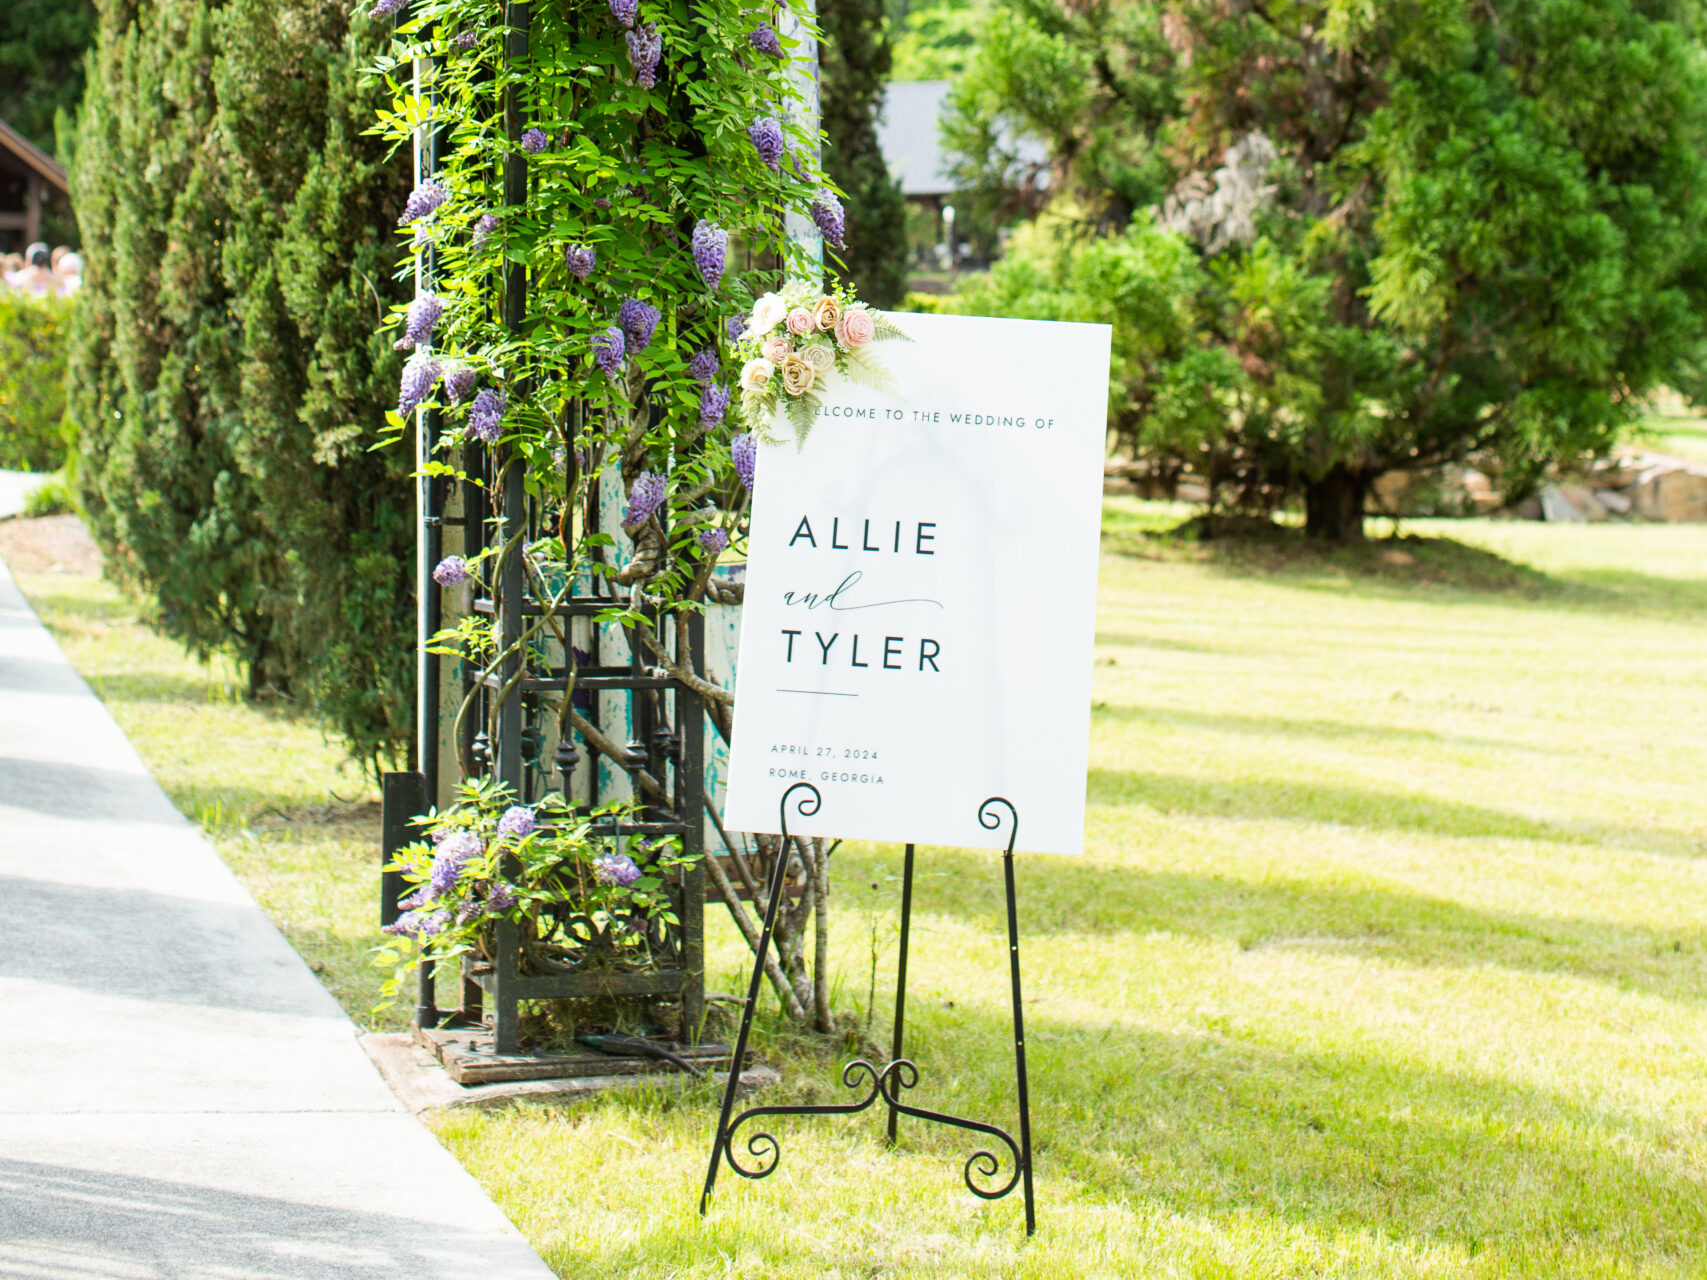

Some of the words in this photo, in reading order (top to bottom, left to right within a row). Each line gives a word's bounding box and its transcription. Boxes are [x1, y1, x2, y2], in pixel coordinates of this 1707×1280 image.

[813, 405, 876, 419] ELCOME
[885, 408, 904, 421] TO
[912, 410, 941, 423] THE
[949, 412, 1026, 428] WEDDING
[1034, 417, 1055, 430] OF
[788, 514, 937, 556] ALLIE
[783, 570, 944, 611] and
[781, 628, 941, 673] TYLER
[770, 744, 809, 756] APRIL
[816, 746, 836, 759] 27,
[844, 748, 879, 760] 2024
[768, 767, 813, 781] ROME,
[820, 771, 885, 785] GEORGIA
